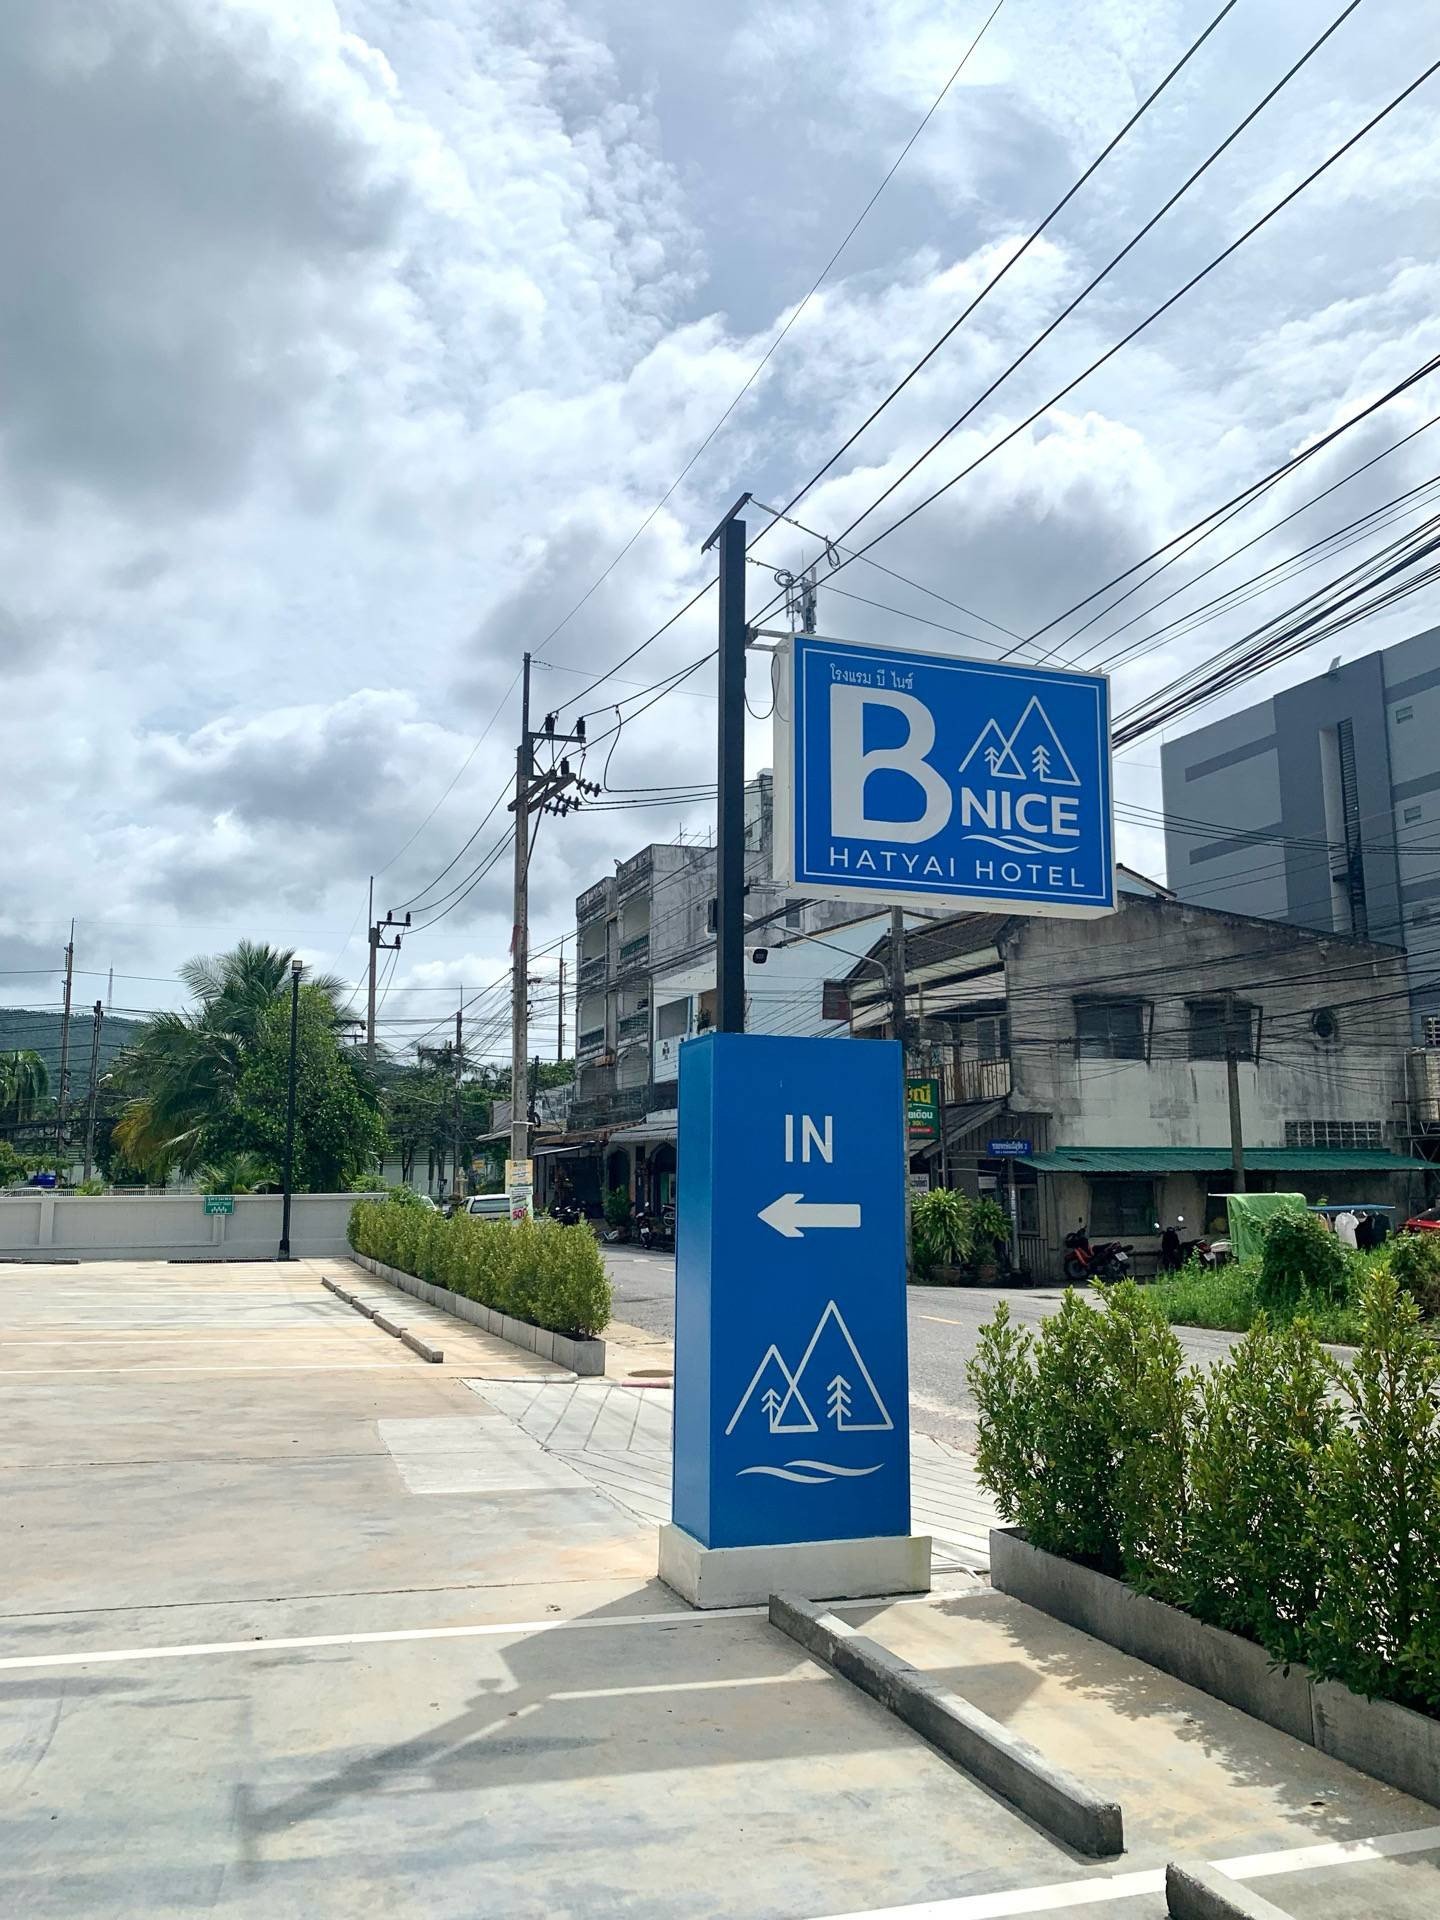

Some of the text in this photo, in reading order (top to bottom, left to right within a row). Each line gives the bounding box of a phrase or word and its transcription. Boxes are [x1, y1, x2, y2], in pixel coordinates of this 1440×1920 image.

[829, 662, 914, 690] โรงแรม บี ไนซ์
[830, 683, 953, 844] B
[961, 787, 1081, 836] NICE
[830, 847, 1085, 887] HATYAI HOTEL
[785, 1114, 833, 1163] IN
